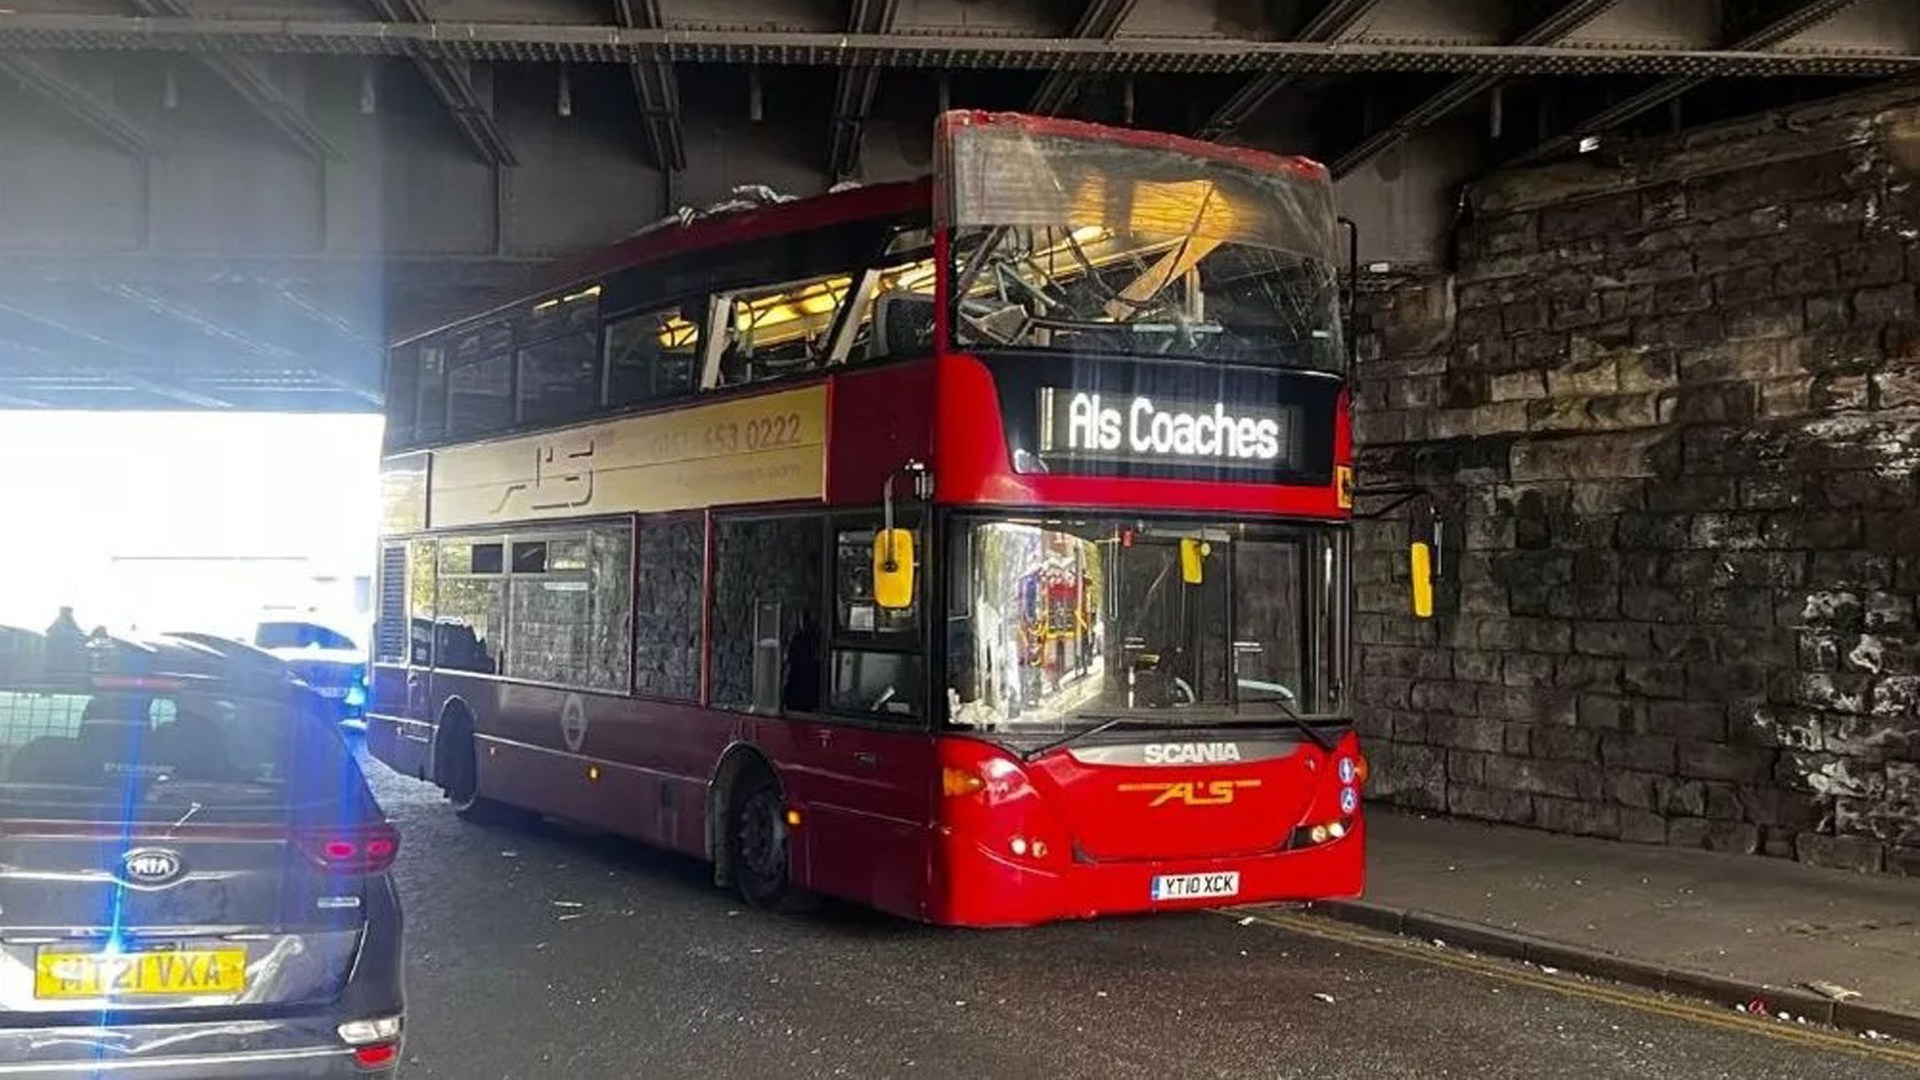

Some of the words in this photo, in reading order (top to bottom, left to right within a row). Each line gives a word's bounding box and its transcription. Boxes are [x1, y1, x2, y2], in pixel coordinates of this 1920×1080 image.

[747, 412, 801, 449] 0222
[1069, 392, 1122, 450] Als
[1129, 397, 1279, 459] Coaches
[1143, 742, 1241, 763] SCANIA
[1165, 876, 1200, 895] YT10
[1204, 874, 1235, 893] XCK
[156, 955, 222, 988] VXA
